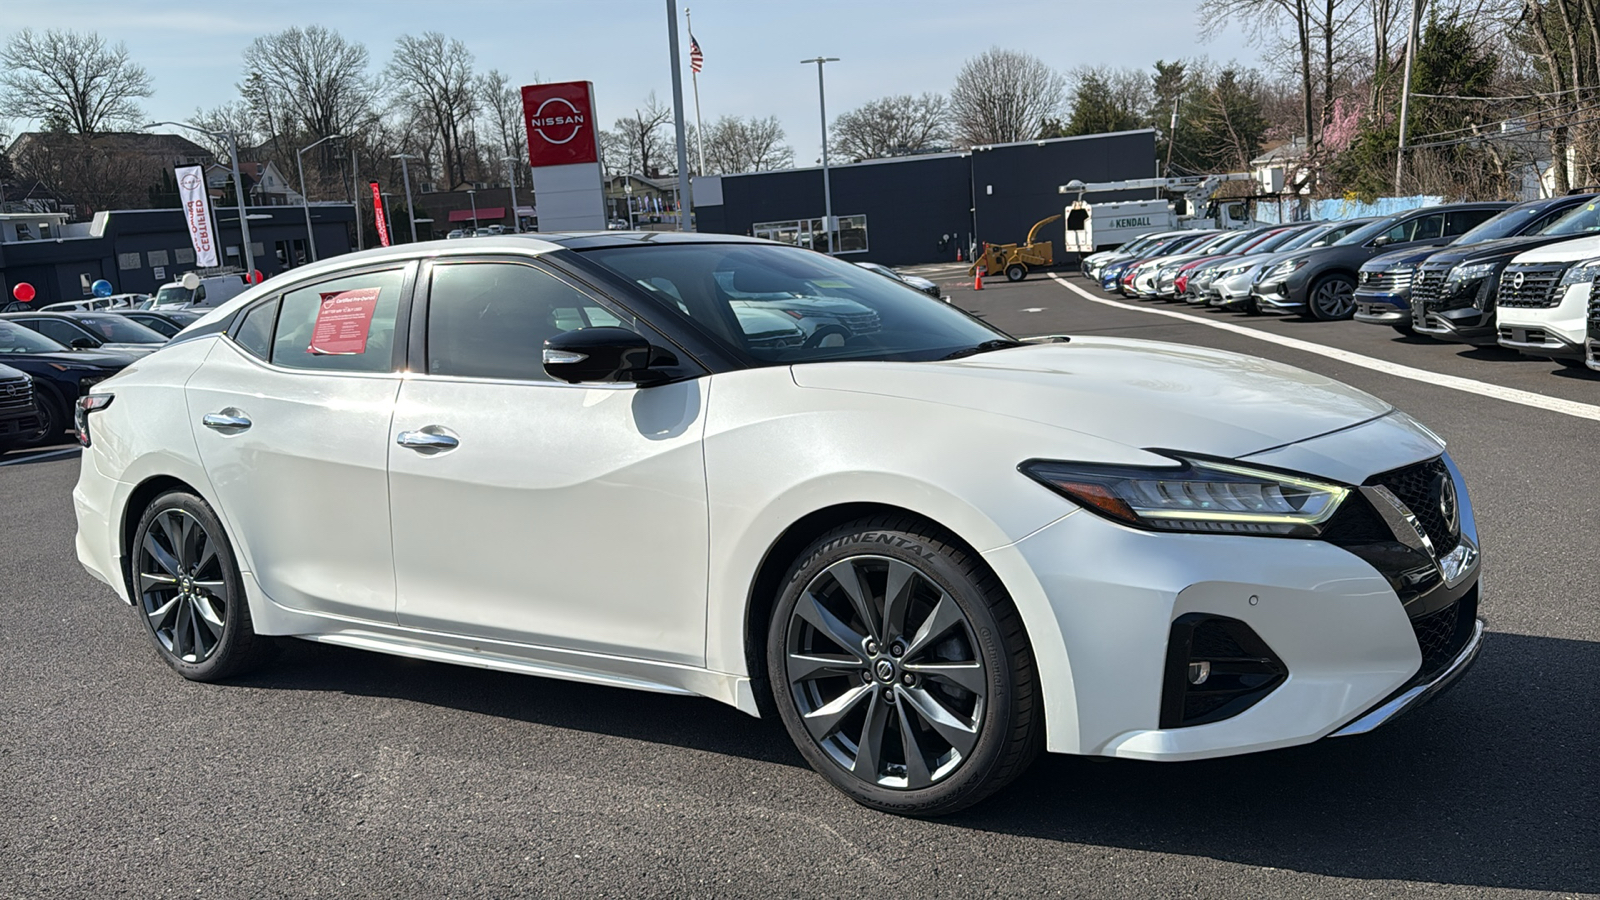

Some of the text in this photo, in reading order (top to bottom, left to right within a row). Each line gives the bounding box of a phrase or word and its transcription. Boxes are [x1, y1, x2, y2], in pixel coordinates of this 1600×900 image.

[532, 114, 584, 127] NISSAN
[1116, 217, 1151, 229] KENDALL
[789, 532, 936, 584] CONTINENTAL
